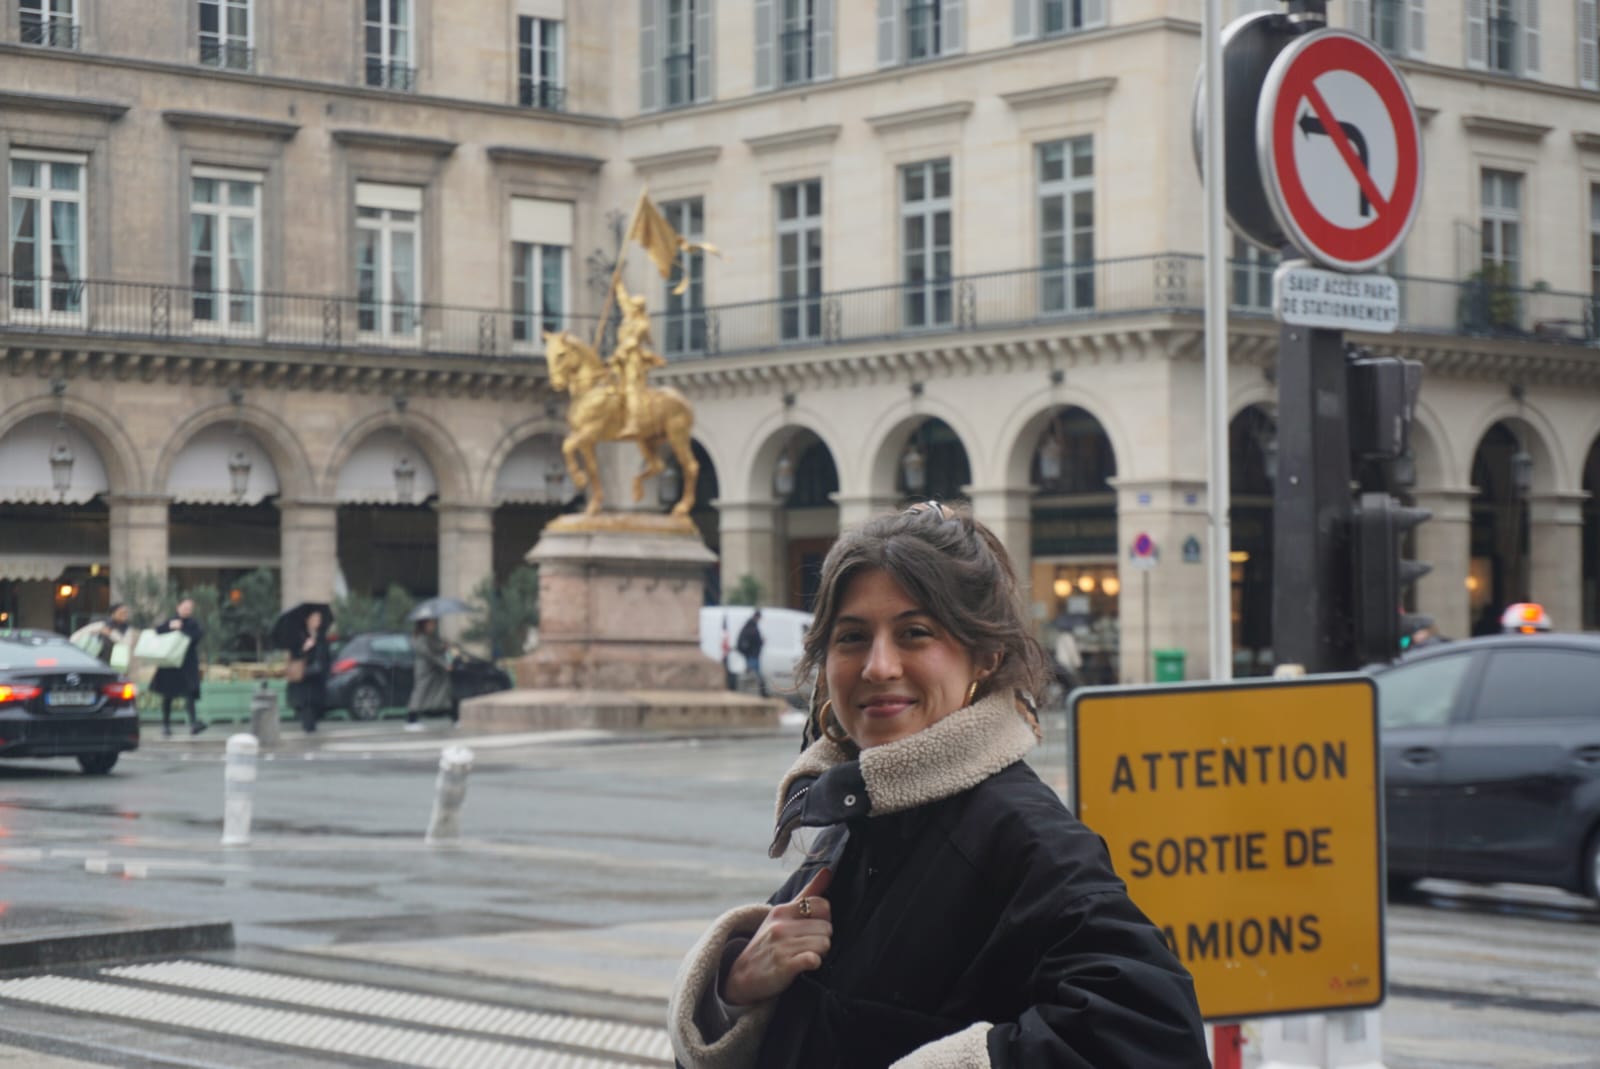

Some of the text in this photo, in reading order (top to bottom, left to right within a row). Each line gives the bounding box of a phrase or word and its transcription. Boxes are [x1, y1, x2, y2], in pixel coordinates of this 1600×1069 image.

[1283, 297, 1397, 322] DE STATIONNEMENT
[1288, 275, 1319, 292] SAUF
[1363, 282, 1392, 300] PARC
[1110, 741, 1347, 793] ATTENTION
[1129, 827, 1333, 878] SORTIE DE
[1162, 914, 1321, 962] AMIONS
